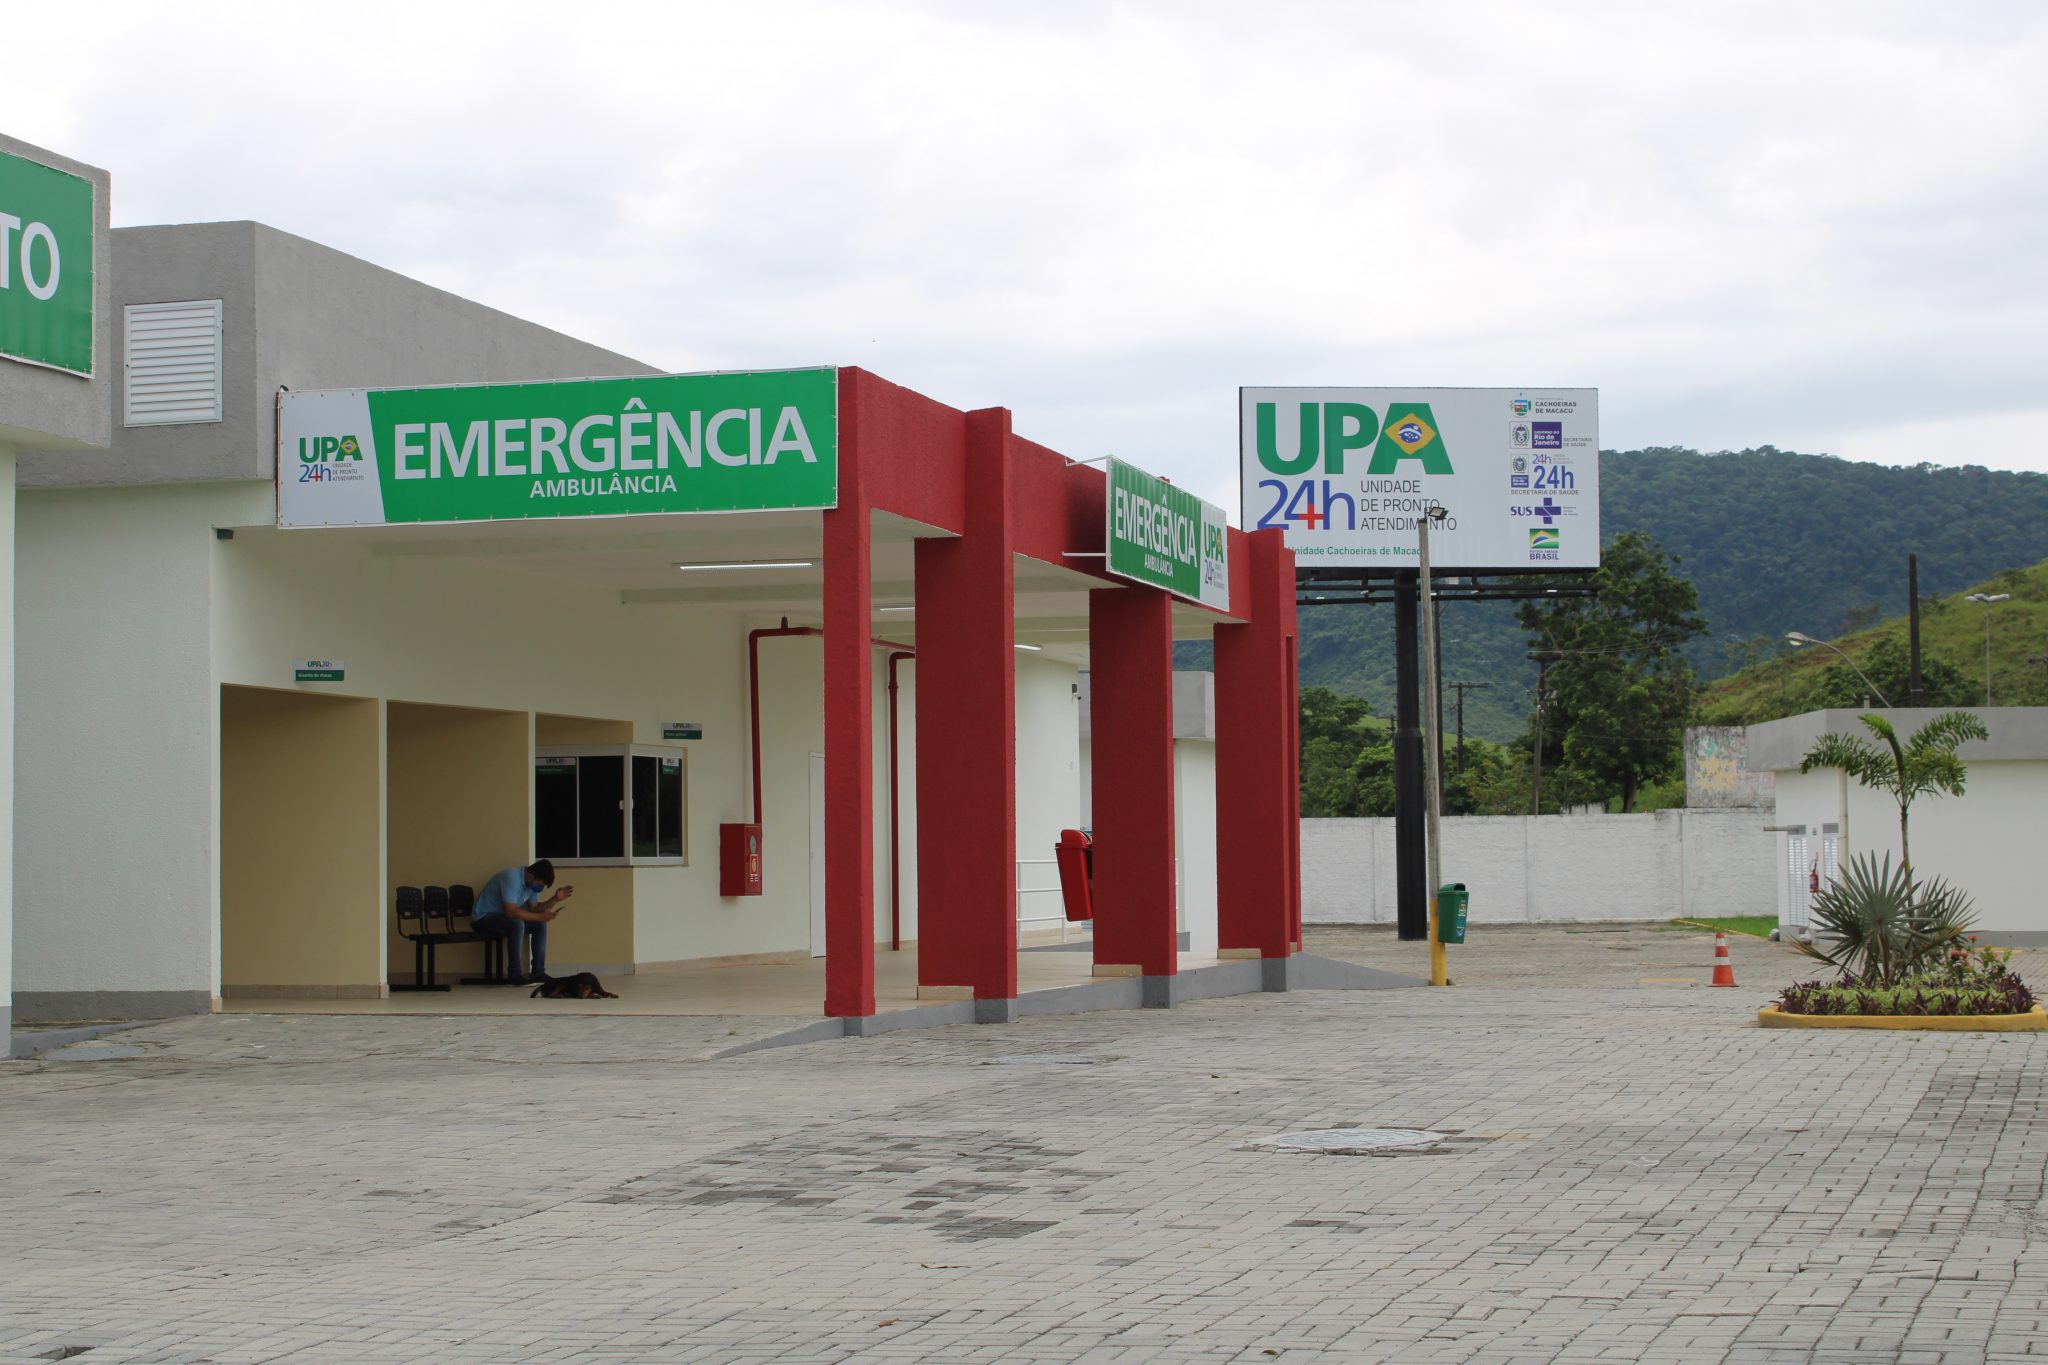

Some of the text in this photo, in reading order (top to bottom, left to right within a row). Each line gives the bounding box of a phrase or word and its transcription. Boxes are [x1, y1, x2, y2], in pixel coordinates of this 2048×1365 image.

[299, 435, 364, 464] UPA
[394, 397, 818, 480] EMERGÊNCIA
[1257, 402, 1455, 476] UPA
[1532, 453, 1552, 465] 24h
[298, 463, 332, 483] 24h
[530, 473, 677, 498] AMBULÂNCIA
[1533, 464, 1575, 489] 24h
[1360, 479, 1421, 493] UNIDADE
[1257, 479, 1356, 531] 24h
[1360, 498, 1440, 512] DE PRONTO
[1510, 506, 1533, 516] SUS
[1115, 485, 1198, 568] EMERGÊNCIA
[1360, 517, 1457, 531] ATENDIMNTO
[1203, 521, 1225, 564] UPA
[1327, 546, 1377, 556] Cachoeiras
[1380, 546, 1390, 556] de
[1144, 552, 1174, 578] AMBULÂNCIA
